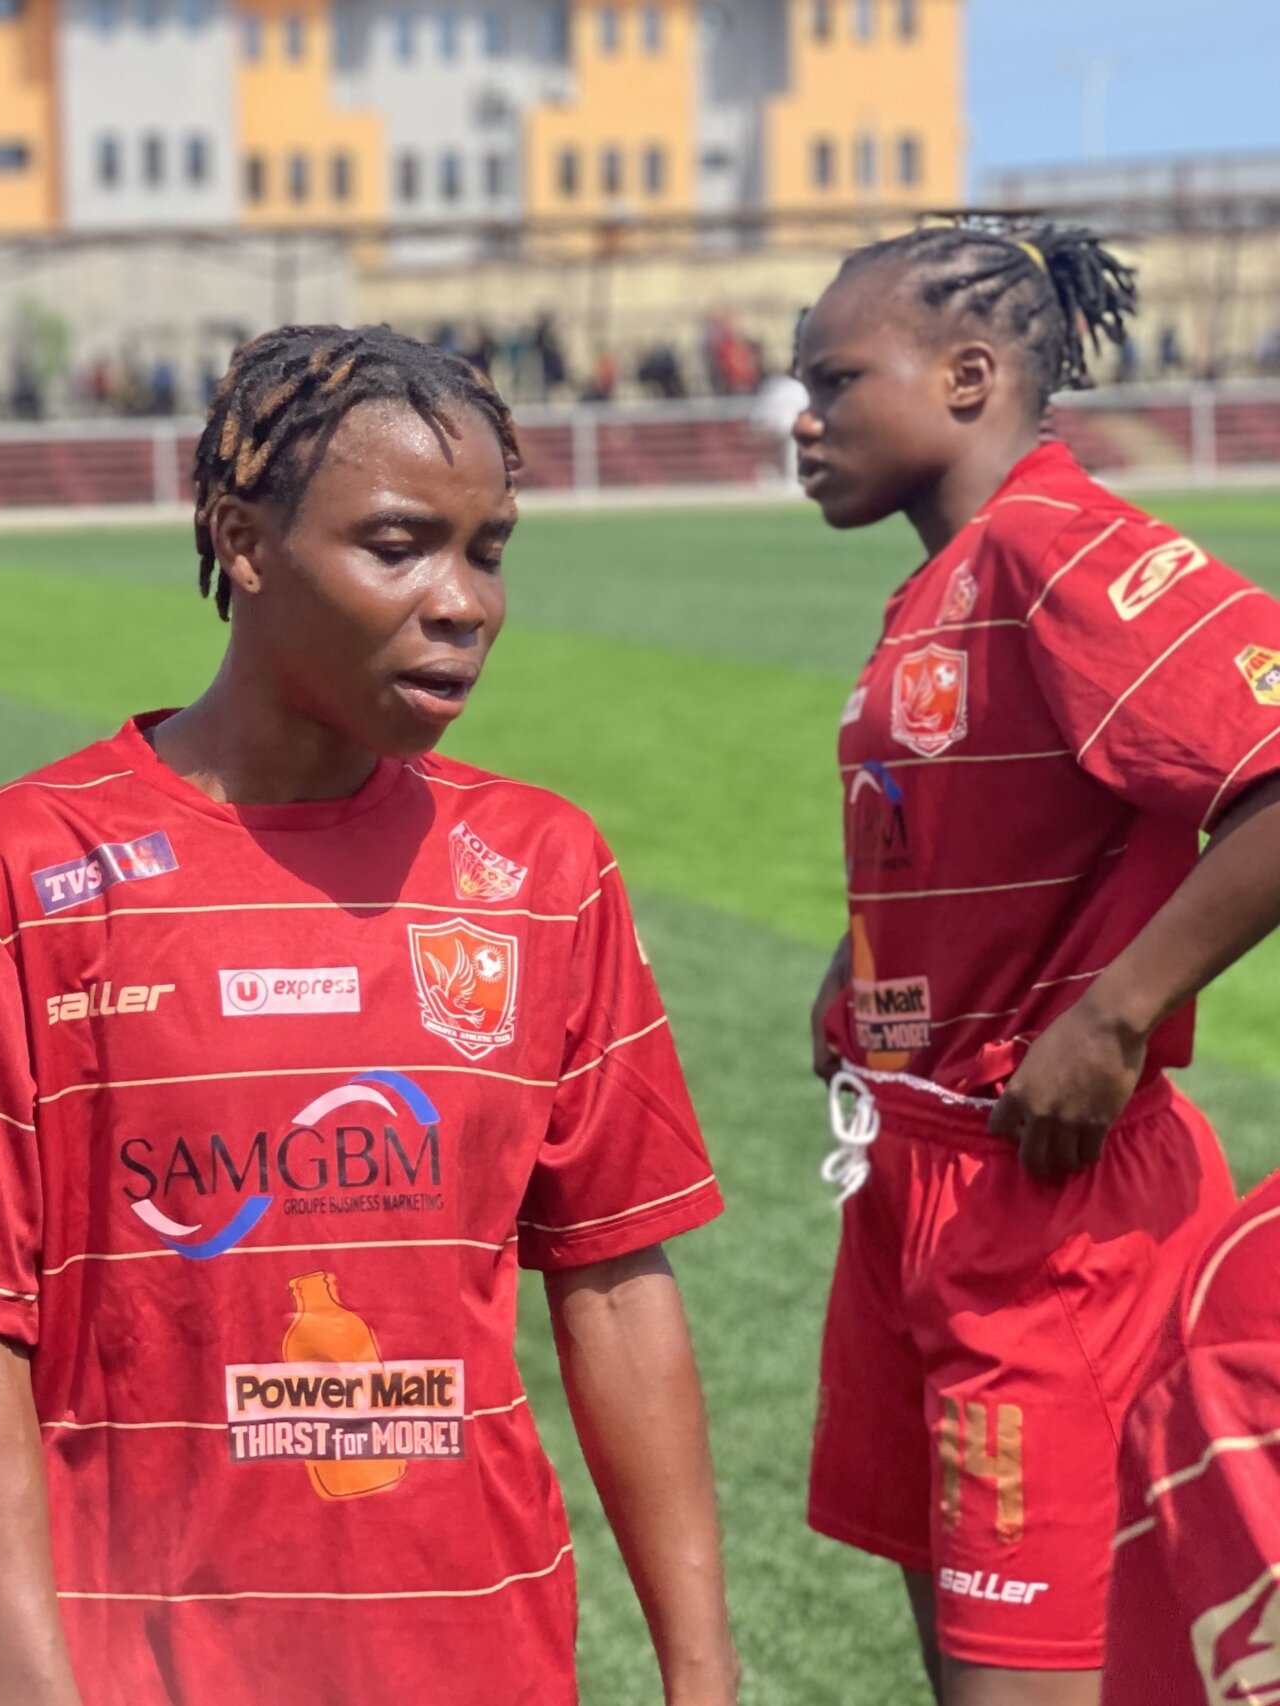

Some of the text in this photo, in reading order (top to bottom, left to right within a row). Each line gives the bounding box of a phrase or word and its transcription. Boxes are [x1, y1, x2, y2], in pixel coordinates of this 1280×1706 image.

[462, 822, 523, 880] TOPAZ
[45, 860, 102, 902] TVS
[46, 981, 175, 1025] saller
[236, 977, 357, 1002] U express
[874, 985, 926, 1015] Malt
[120, 1124, 442, 1200] SAMGBM
[283, 1192, 444, 1216] GROUPE BUSINESS MARKETING
[235, 1369, 453, 1411] Power Malt
[231, 1421, 461, 1460] THIRST for MORE!
[939, 1397, 1023, 1544] 14
[939, 1567, 1049, 1604] saller
